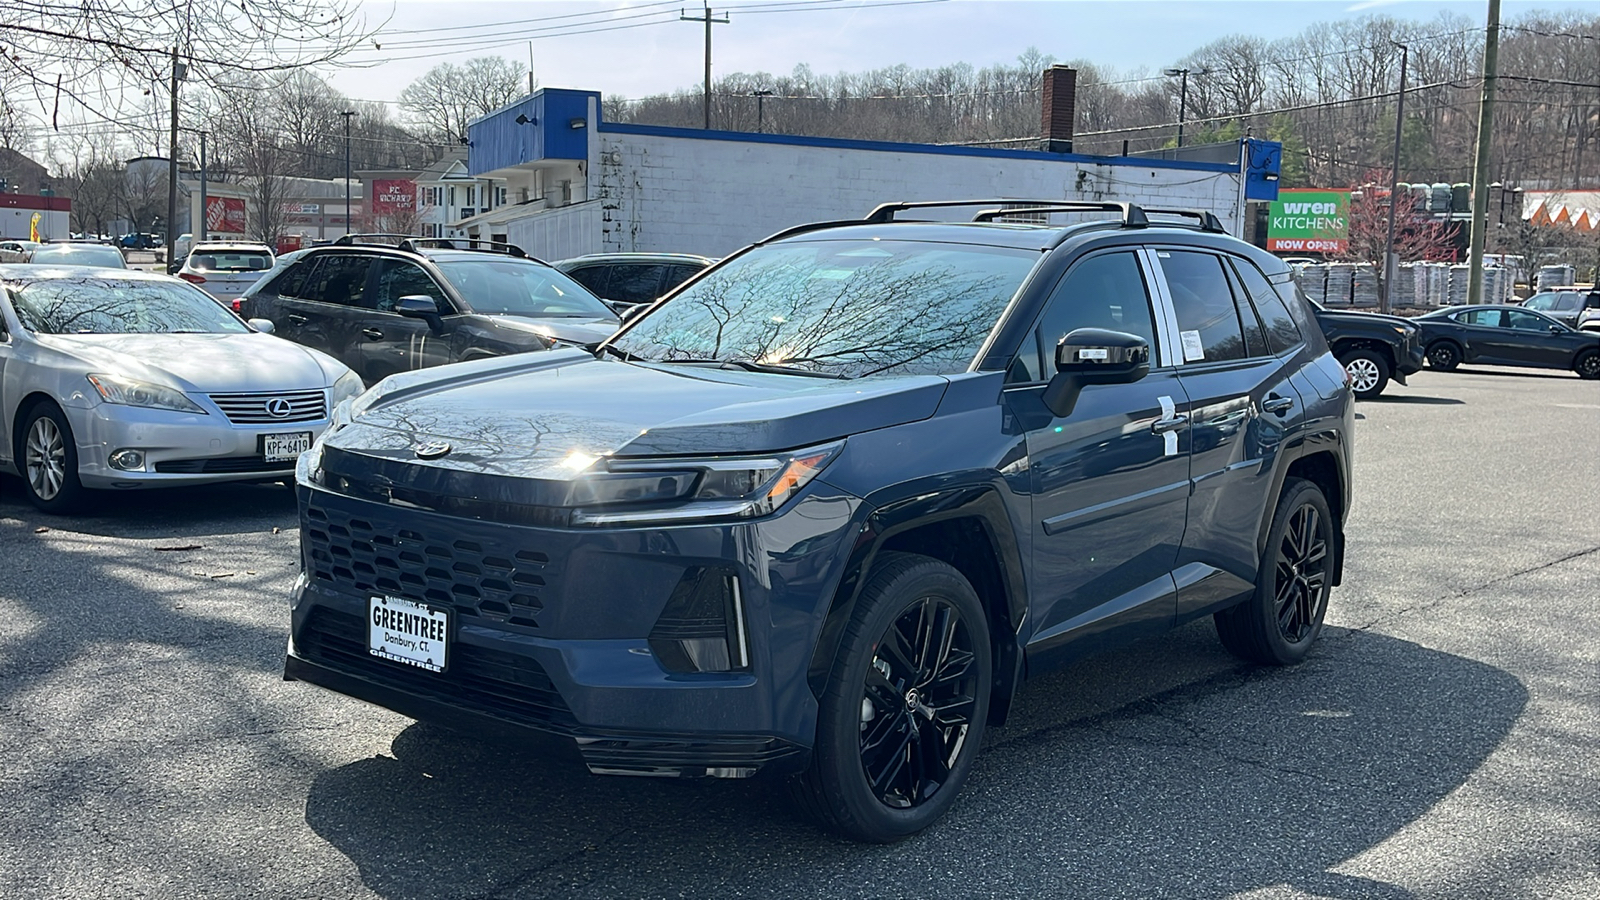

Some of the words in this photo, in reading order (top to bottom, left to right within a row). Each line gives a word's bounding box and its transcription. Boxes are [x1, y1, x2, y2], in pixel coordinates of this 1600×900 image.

[380, 194, 411, 202] RICHARD
[206, 198, 225, 230] HOME
[1283, 202, 1337, 215] wren
[1273, 217, 1344, 229] KITCHENS
[1276, 240, 1304, 249] NOW
[1306, 240, 1338, 250] OPEN
[373, 606, 444, 642] GREENTREE
[385, 632, 417, 652] Danbury,
[419, 641, 430, 652] CT.
[369, 649, 441, 672] GREENTREE
